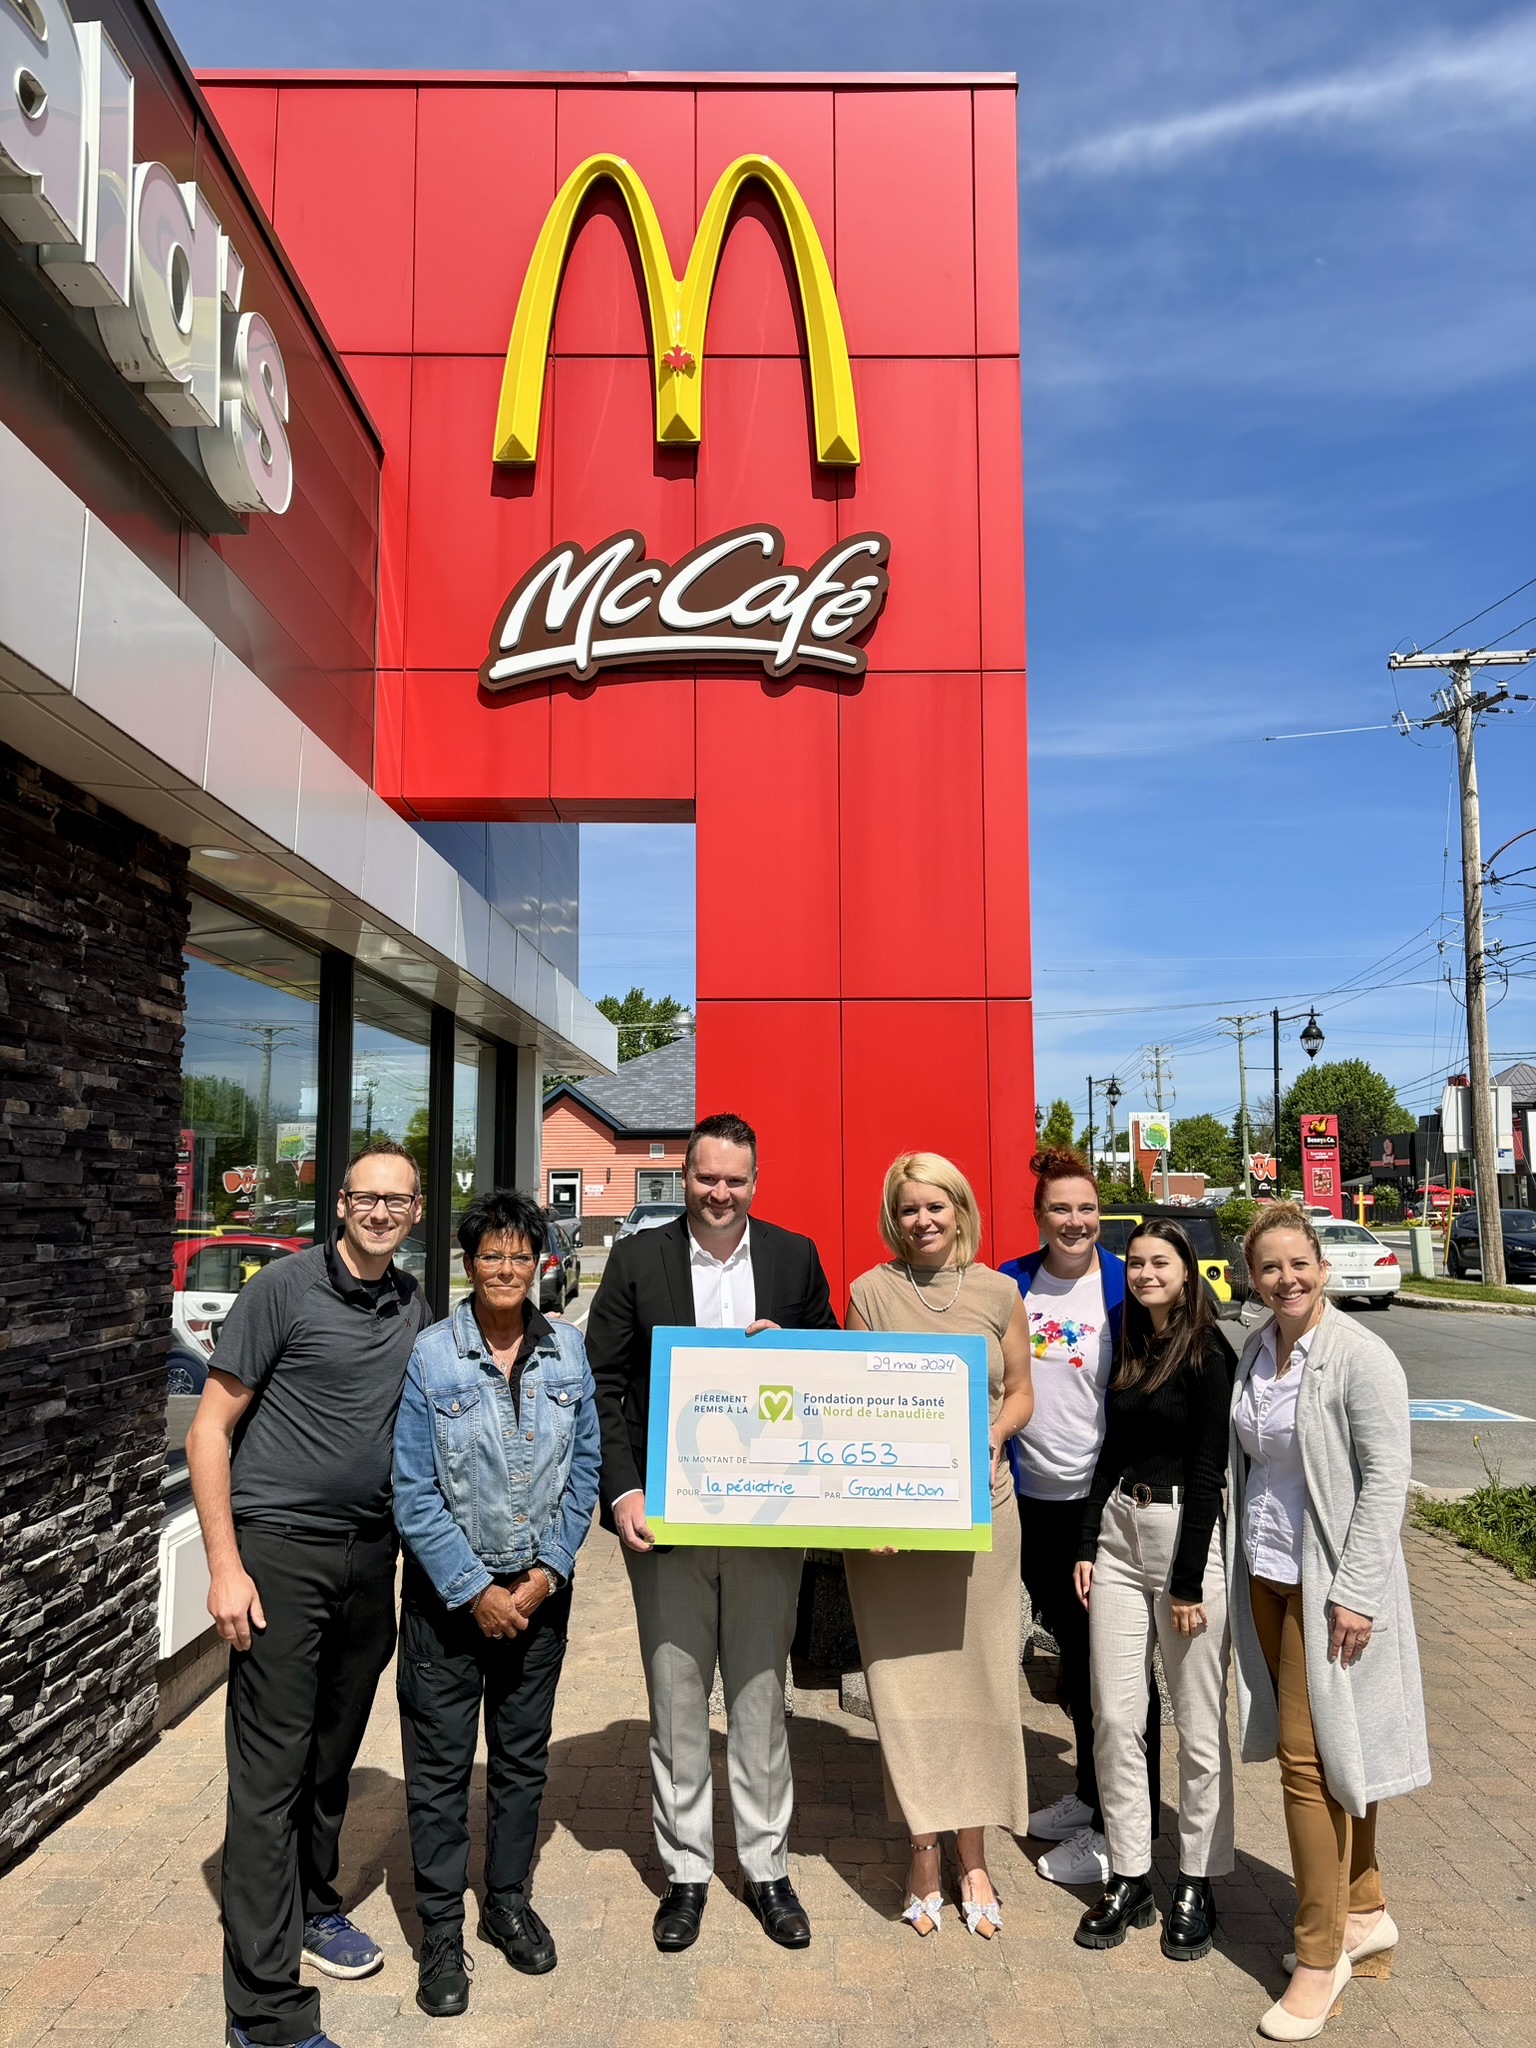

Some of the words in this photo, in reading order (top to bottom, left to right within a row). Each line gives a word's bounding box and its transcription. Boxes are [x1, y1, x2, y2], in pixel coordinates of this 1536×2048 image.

[489, 531, 881, 680] McCafé
[873, 1356, 891, 1370] 29
[893, 1361, 917, 1370] mai
[921, 1358, 955, 1371] 2024
[694, 1393, 748, 1404] FIÈREMENT
[803, 1393, 864, 1405] Fondation
[867, 1397, 896, 1408] pour
[898, 1395, 909, 1406] la
[911, 1395, 945, 1407] Santé
[694, 1405, 724, 1413] REMIS
[726, 1404, 734, 1414] À
[736, 1406, 749, 1414] LA
[803, 1405, 819, 1416] du
[823, 1406, 853, 1417] Nord
[857, 1407, 872, 1418] de
[876, 1407, 945, 1419] Lanaudière
[677, 1455, 690, 1463] UN
[692, 1456, 734, 1464] MONTANT
[736, 1456, 748, 1464] DE
[676, 1488, 700, 1496] POUR
[706, 1476, 722, 1493] la
[726, 1478, 795, 1496] pédiatrie
[848, 1478, 893, 1497] Grand
[896, 1482, 945, 1497] McDon
[824, 1491, 841, 1499] PAR
